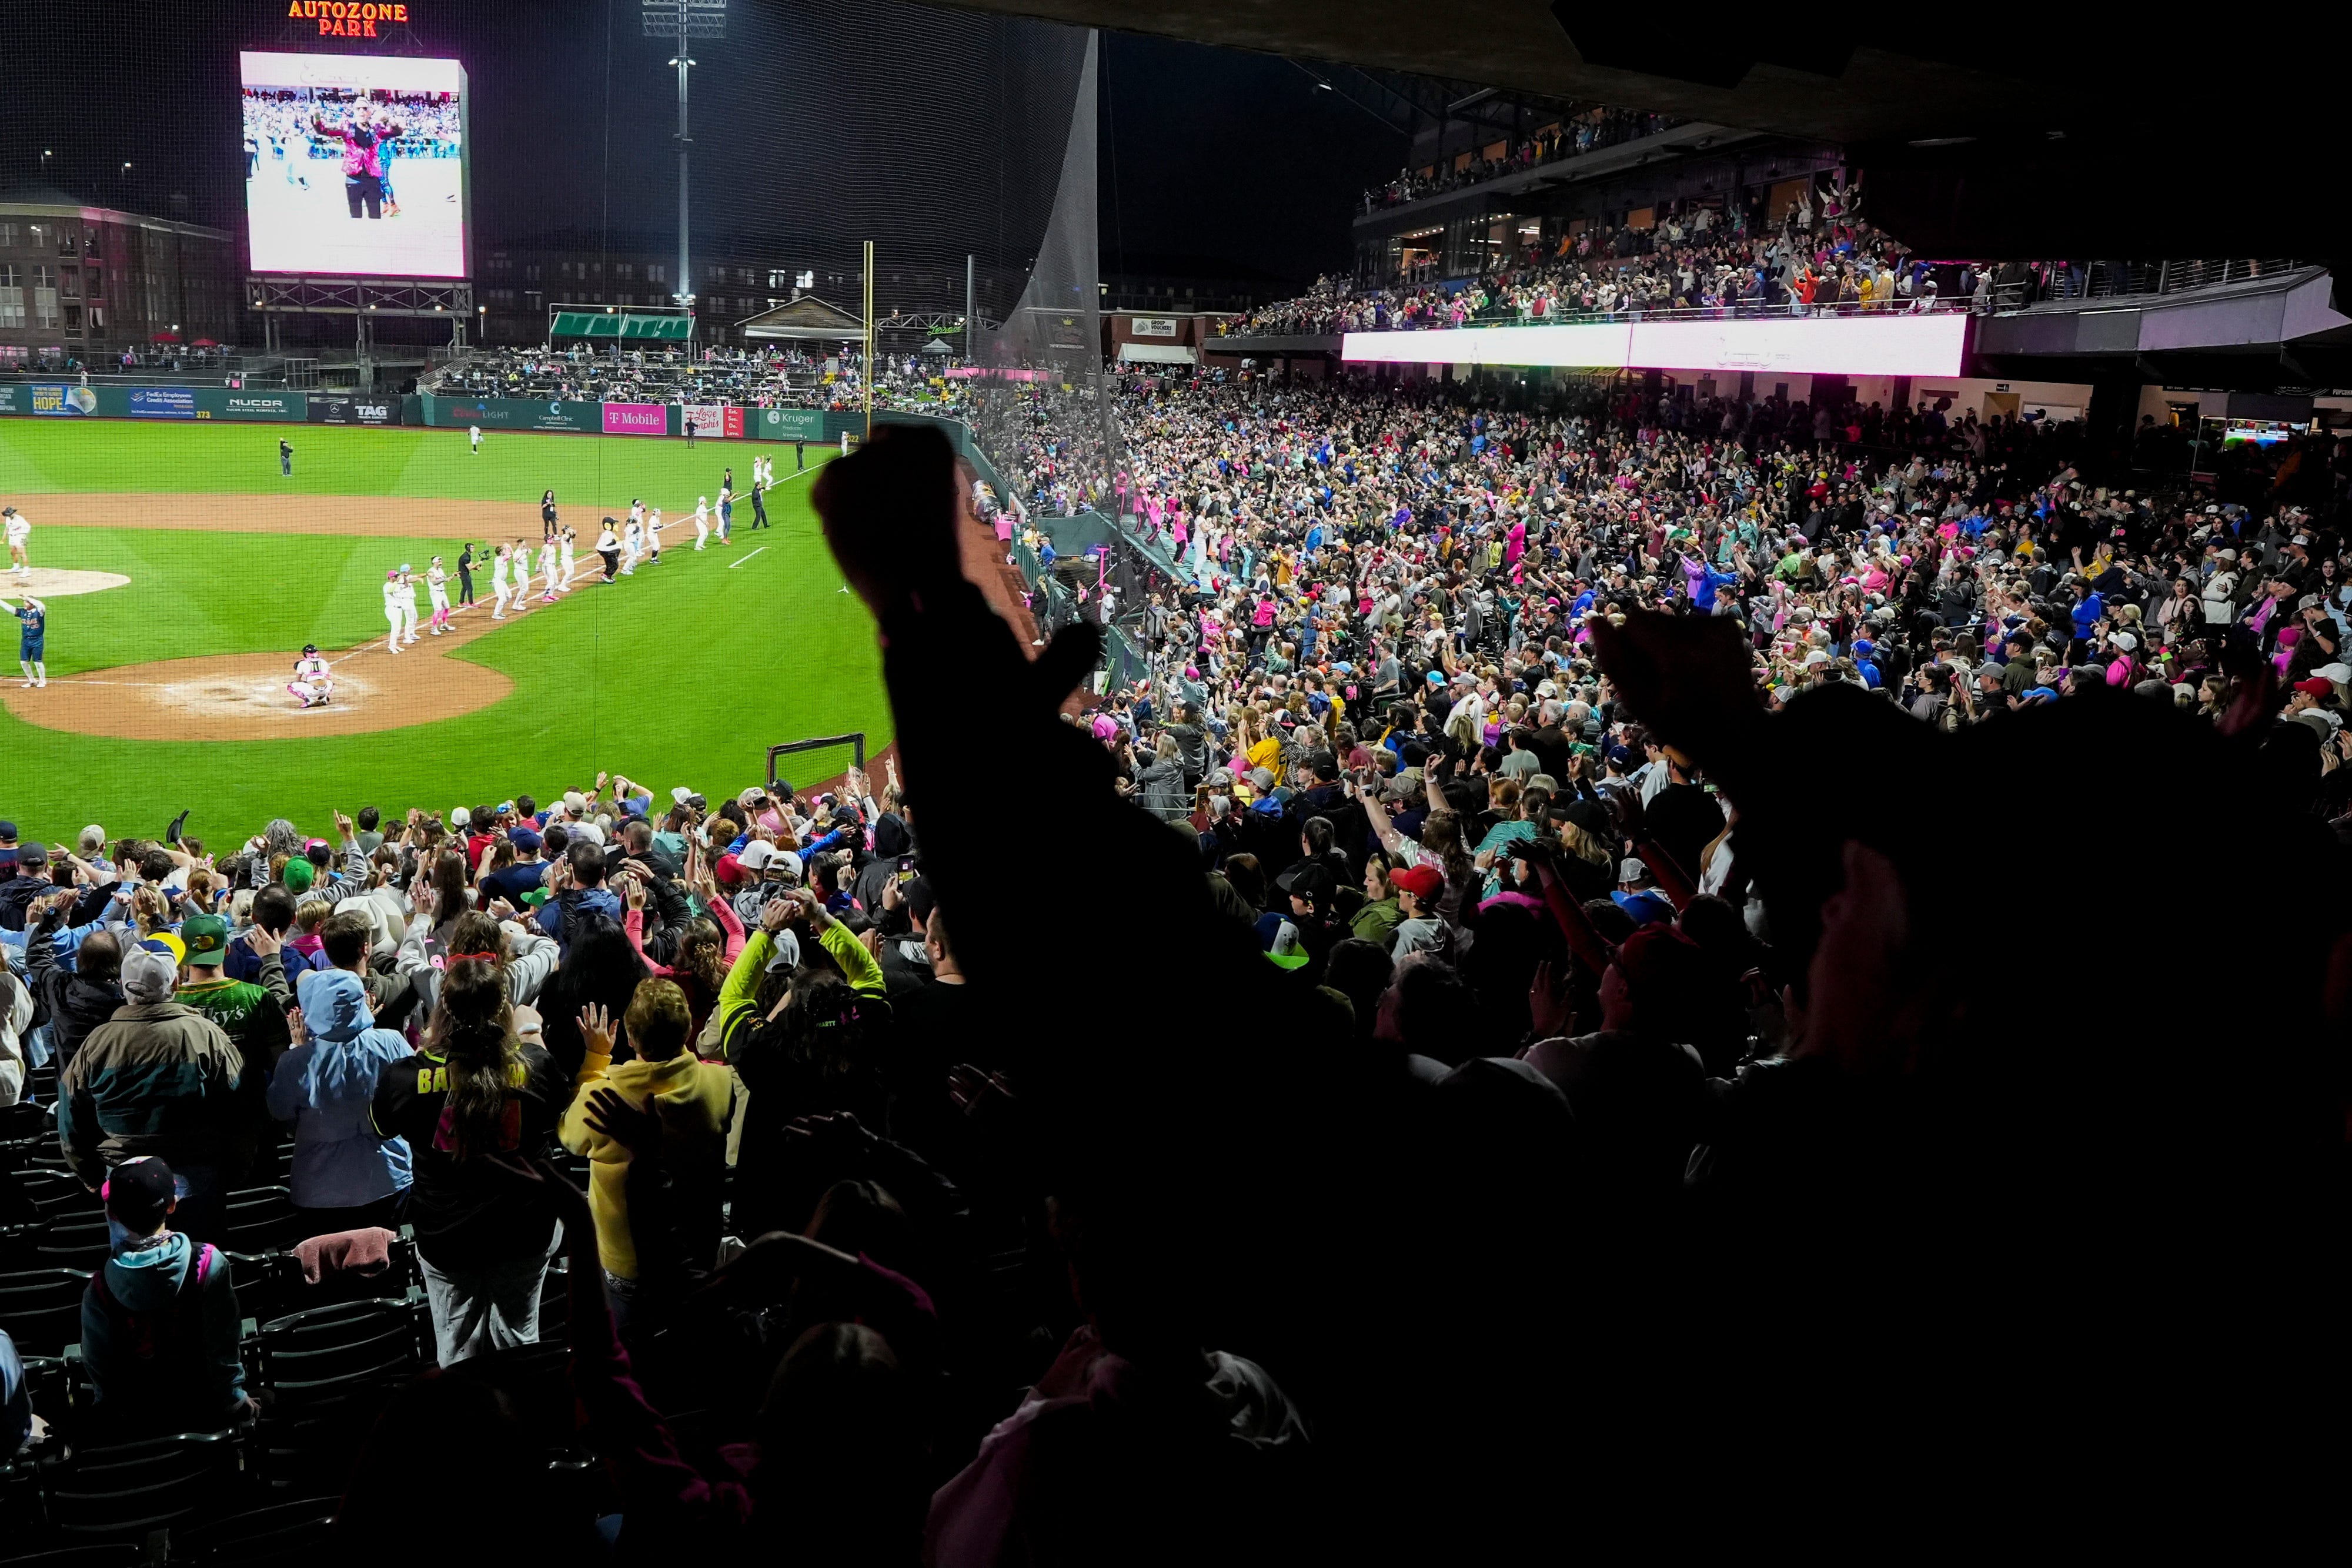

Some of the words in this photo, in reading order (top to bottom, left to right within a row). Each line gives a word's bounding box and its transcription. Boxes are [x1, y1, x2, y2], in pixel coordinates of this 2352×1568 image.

[288, 1, 408, 22] AUTOZONE
[318, 18, 377, 38] PARK
[33, 396, 67, 410] HOPE.
[355, 406, 387, 416] TAG
[482, 411, 509, 419] LIGHT
[694, 407, 717, 422] Love
[609, 412, 619, 424] T
[622, 412, 659, 425] Mobile
[782, 413, 814, 424] Kruger
